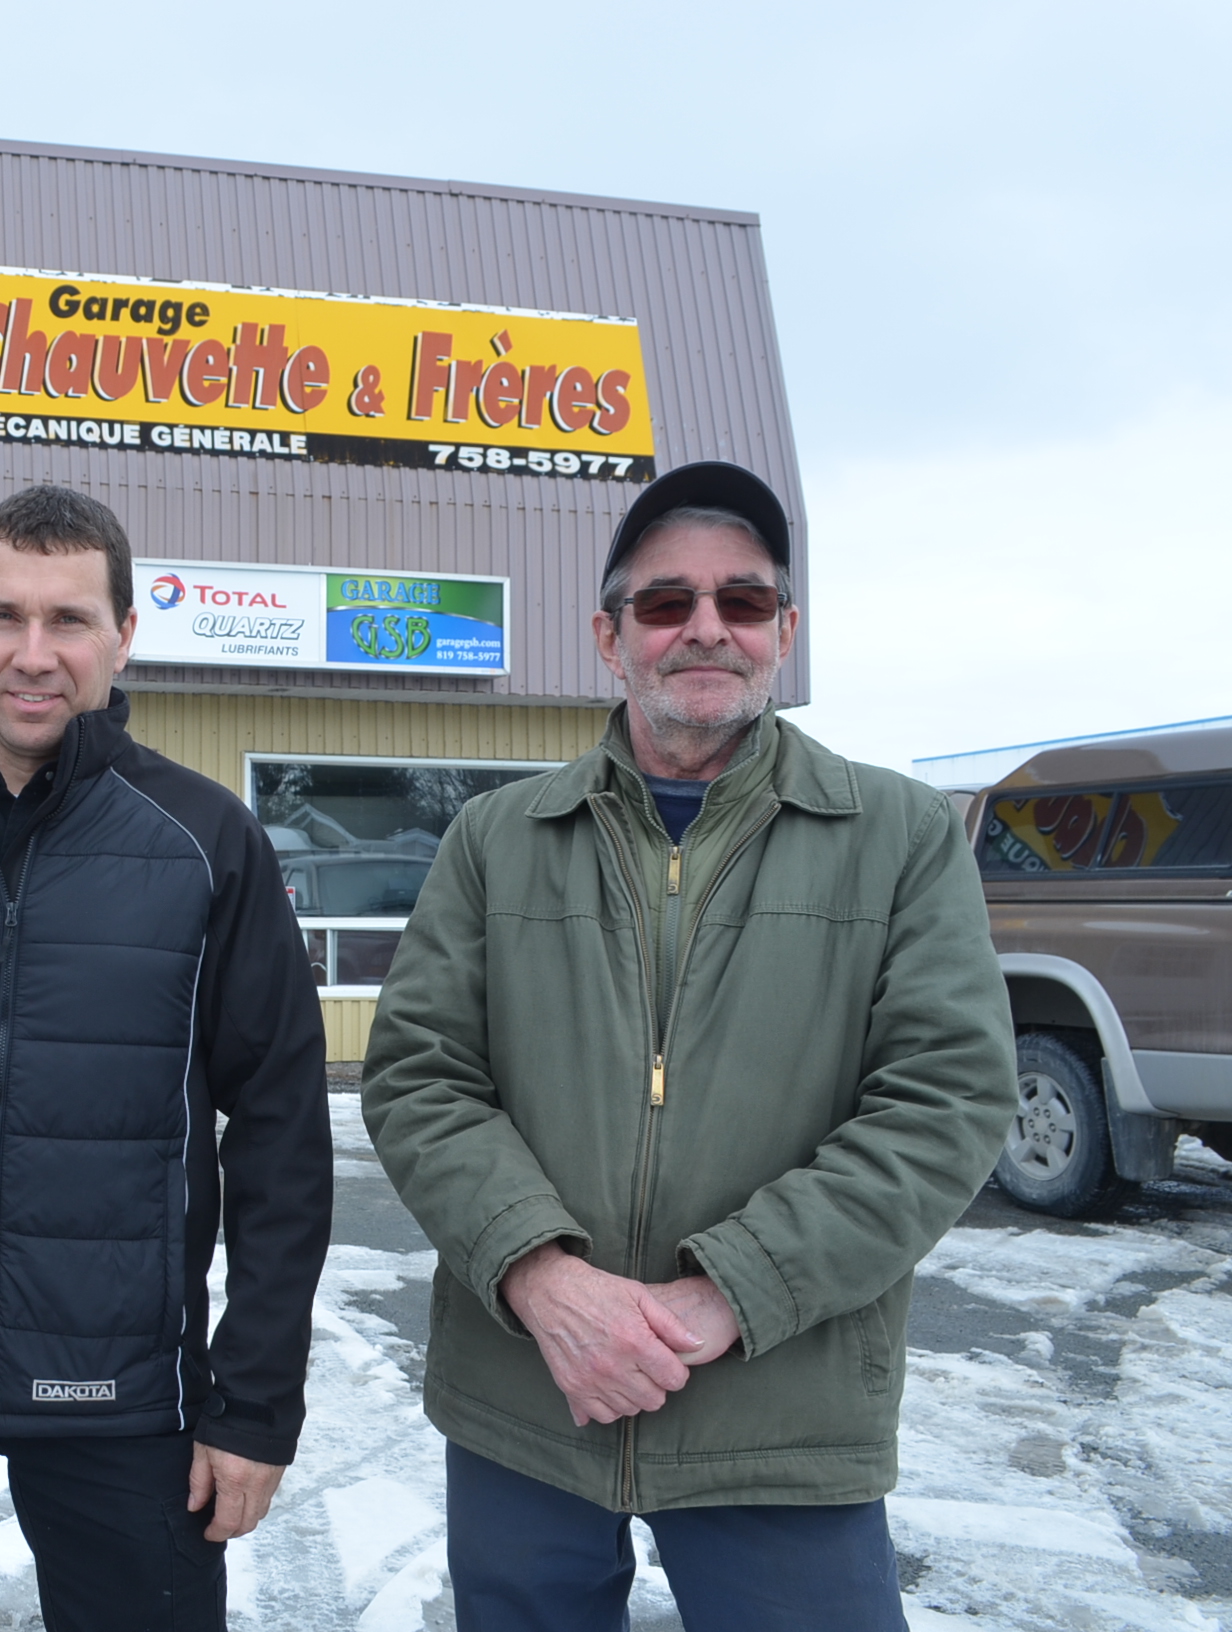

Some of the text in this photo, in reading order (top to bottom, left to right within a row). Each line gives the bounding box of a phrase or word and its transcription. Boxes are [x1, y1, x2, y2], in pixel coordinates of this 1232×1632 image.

[49, 285, 211, 336] Garage
[347, 364, 386, 418] &
[407, 328, 632, 436] Frères
[151, 424, 308, 456] GÉNÉRALE
[428, 444, 634, 477] 758-5977
[193, 585, 287, 609] TOTAL
[341, 579, 442, 605] GARAGE
[192, 612, 305, 641] QUARTZ
[350, 613, 432, 660] GSB
[221, 643, 299, 657] LUBRIFIANTS
[436, 637, 501, 650] garagegsb.com
[436, 650, 501, 662] 819 758-5977
[37, 1384, 112, 1399] DAKOTA
